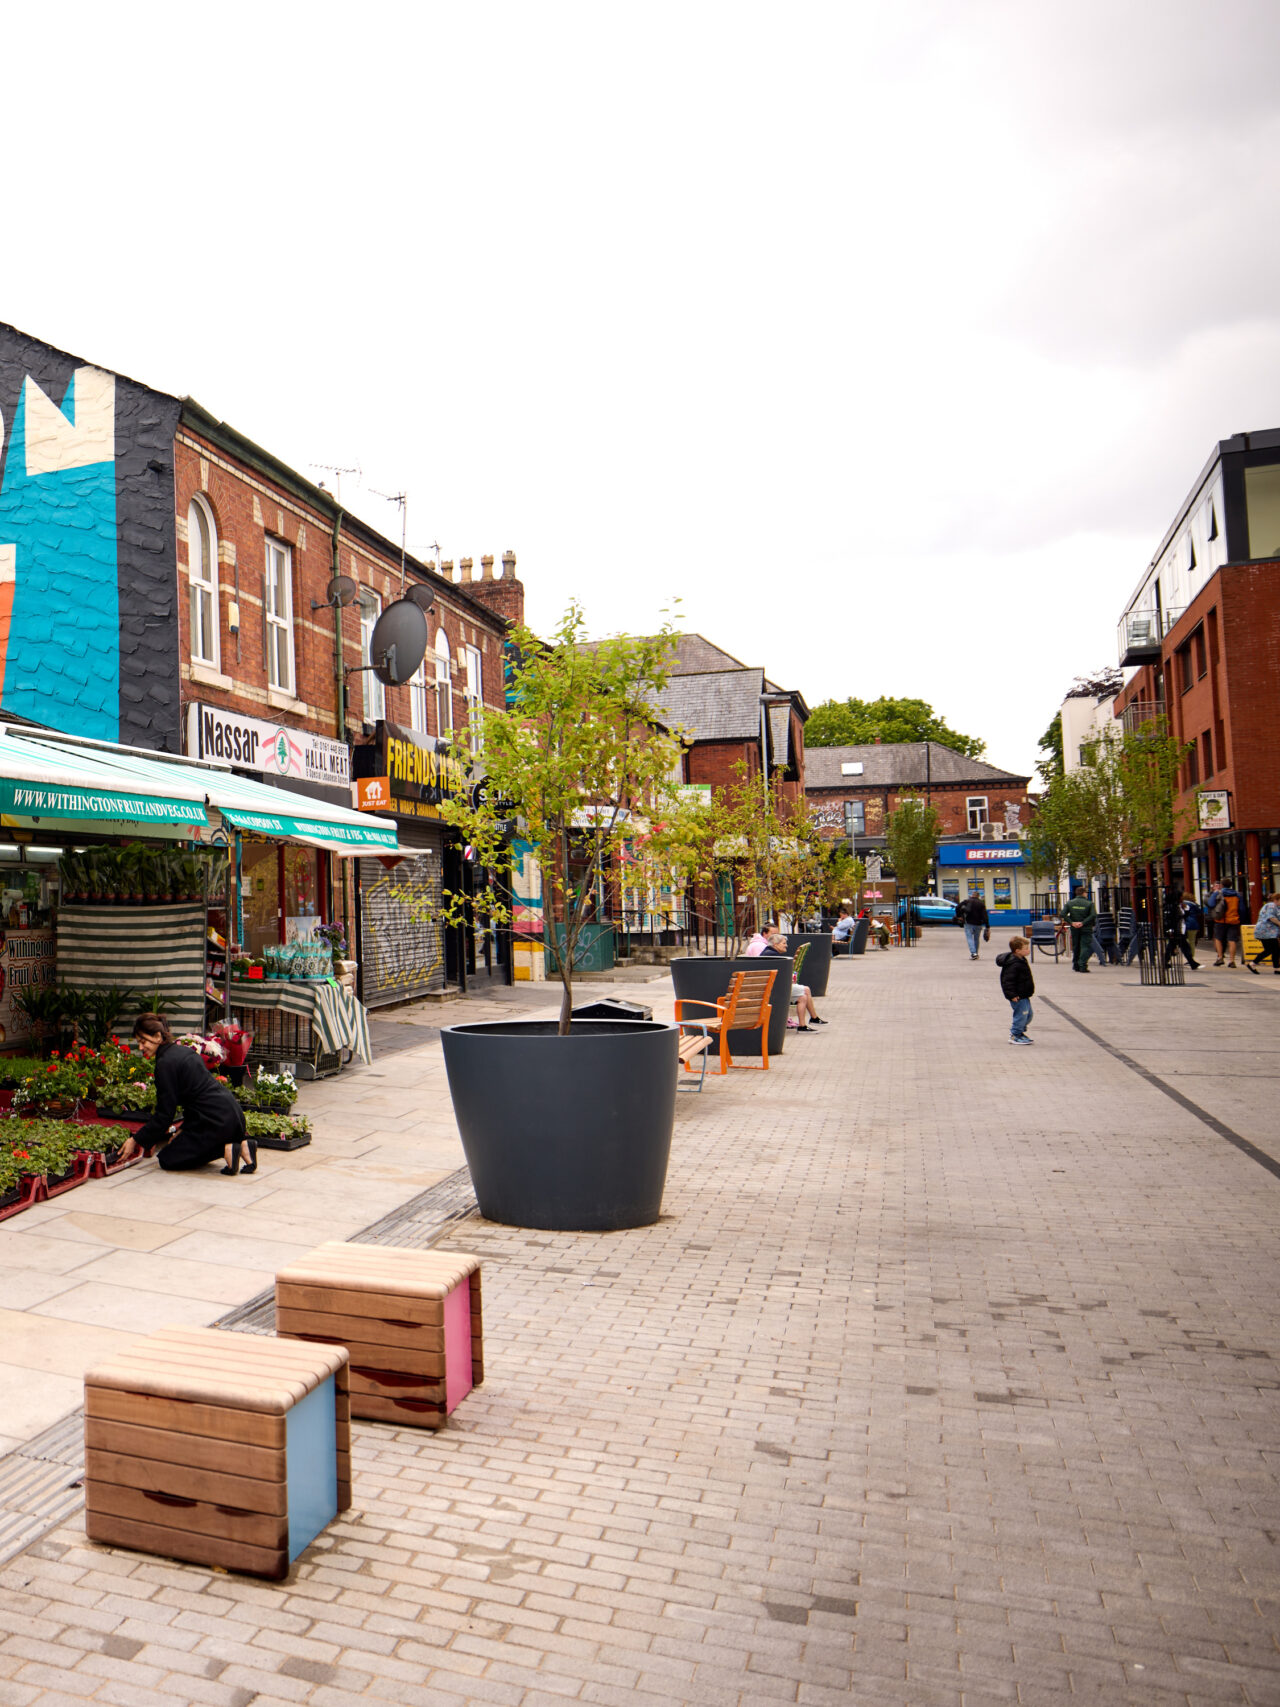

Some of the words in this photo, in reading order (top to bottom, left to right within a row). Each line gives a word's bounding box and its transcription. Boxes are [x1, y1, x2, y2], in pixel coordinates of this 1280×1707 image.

[204, 711, 259, 764] Nassar
[305, 748, 327, 771] HALAL
[329, 754, 348, 776] MEAT
[387, 736, 437, 788] FRIENDS
[13, 788, 206, 821] WWW.WITHINGTONFRUITANDVEG.CO.UK
[967, 849, 1022, 859] BETFRED
[7, 939, 56, 959] Withington
[9, 965, 29, 986] Fruit
[31, 964, 39, 984] &
